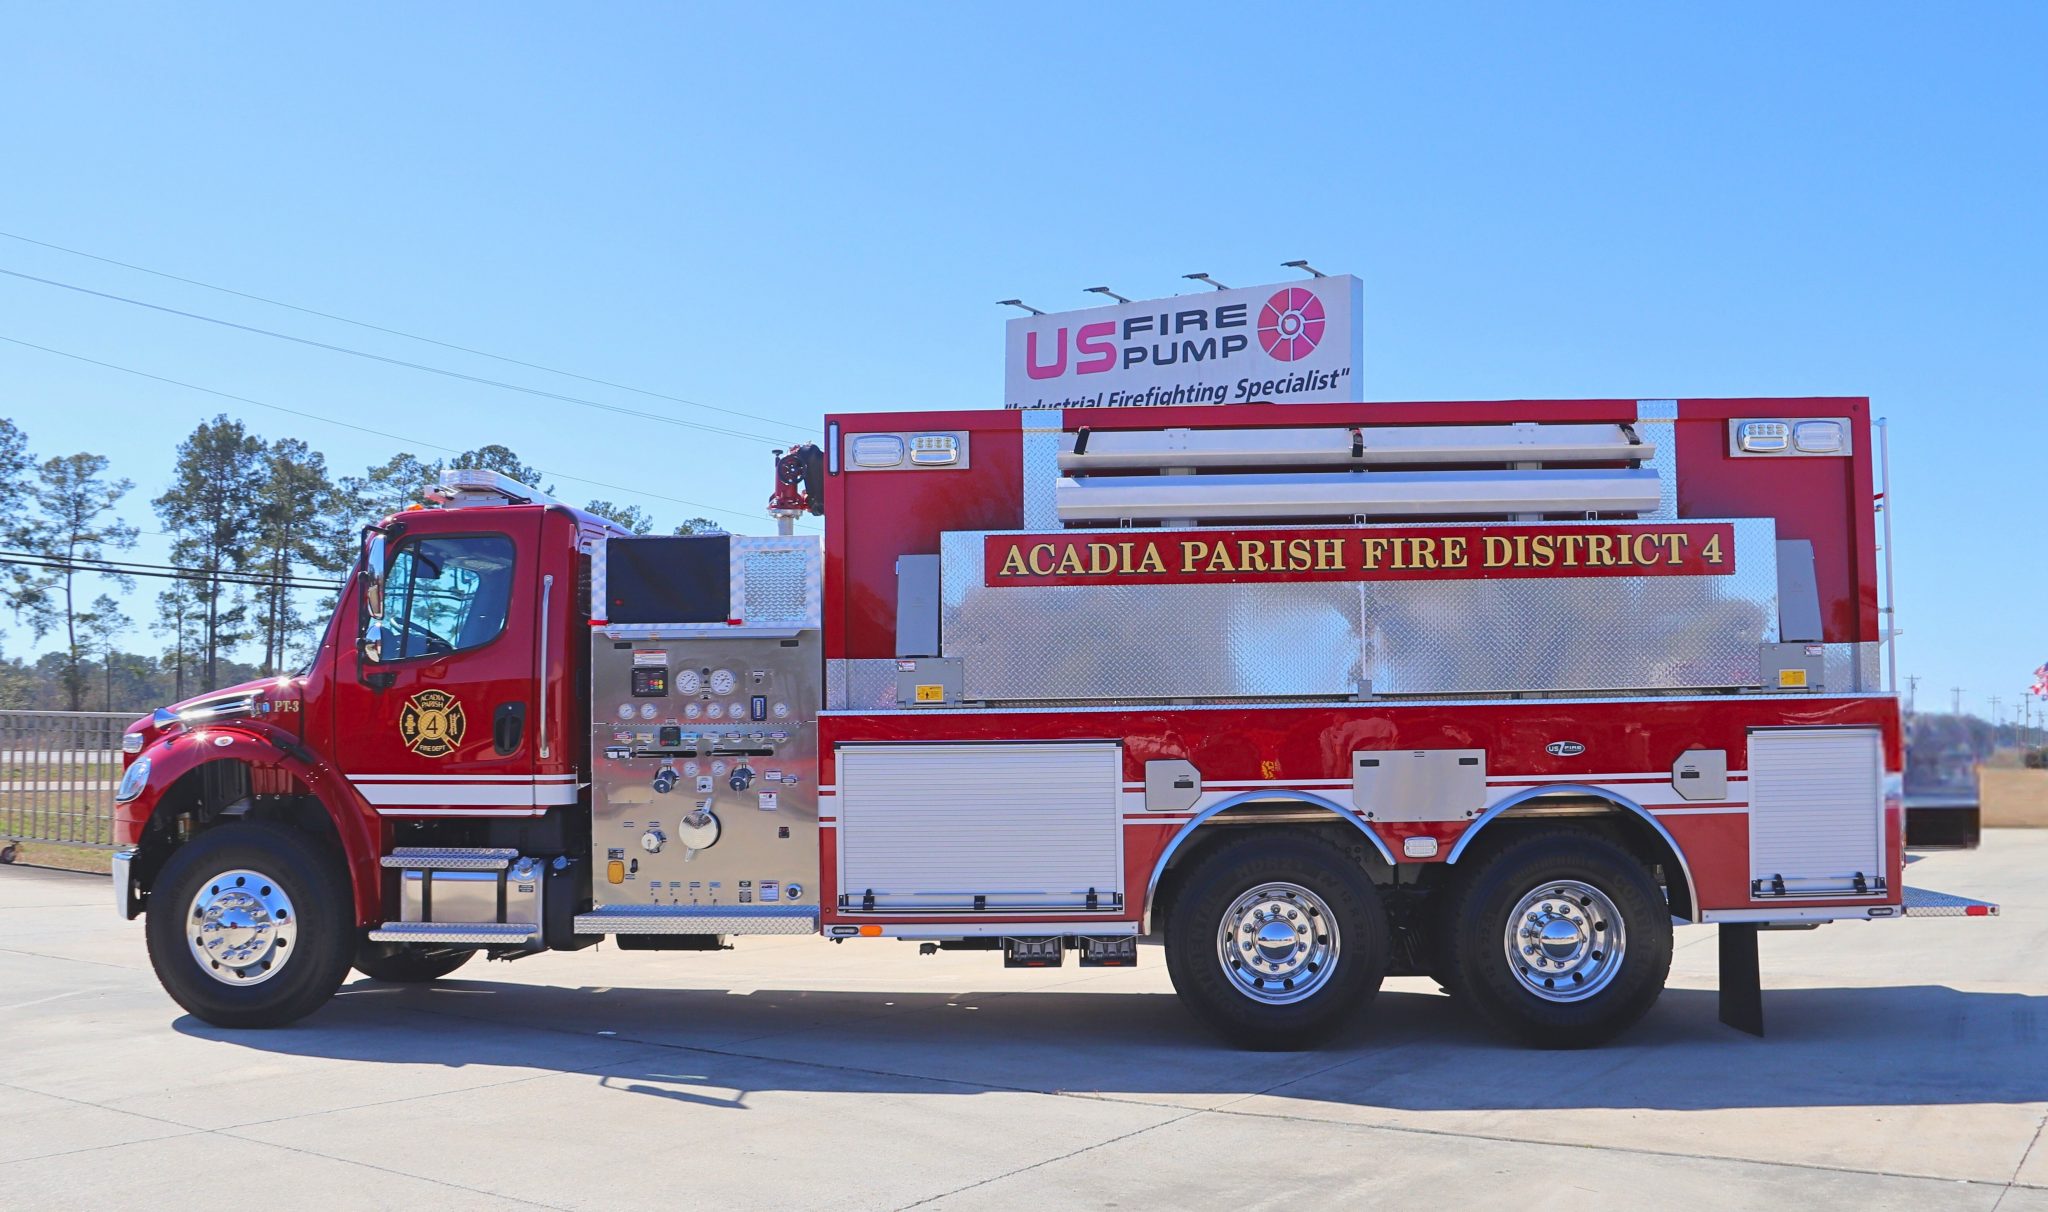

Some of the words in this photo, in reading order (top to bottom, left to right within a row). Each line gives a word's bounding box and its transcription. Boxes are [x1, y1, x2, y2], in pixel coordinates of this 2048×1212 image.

[1123, 304, 1247, 340] FIRE
[1027, 320, 1117, 380] US
[1123, 334, 1248, 369] PUMP
[1108, 382, 1228, 405] Firefighting
[1235, 368, 1350, 404] Specialist"
[999, 542, 1167, 576] ACADIA
[1180, 539, 1346, 573] PARISH
[1362, 536, 1468, 569] FIRE
[1482, 533, 1688, 568] DISTRICT
[1702, 533, 1723, 564] 4
[274, 701, 299, 712] PT-3
[421, 694, 445, 702] ACADIA
[426, 715, 438, 735] 4
